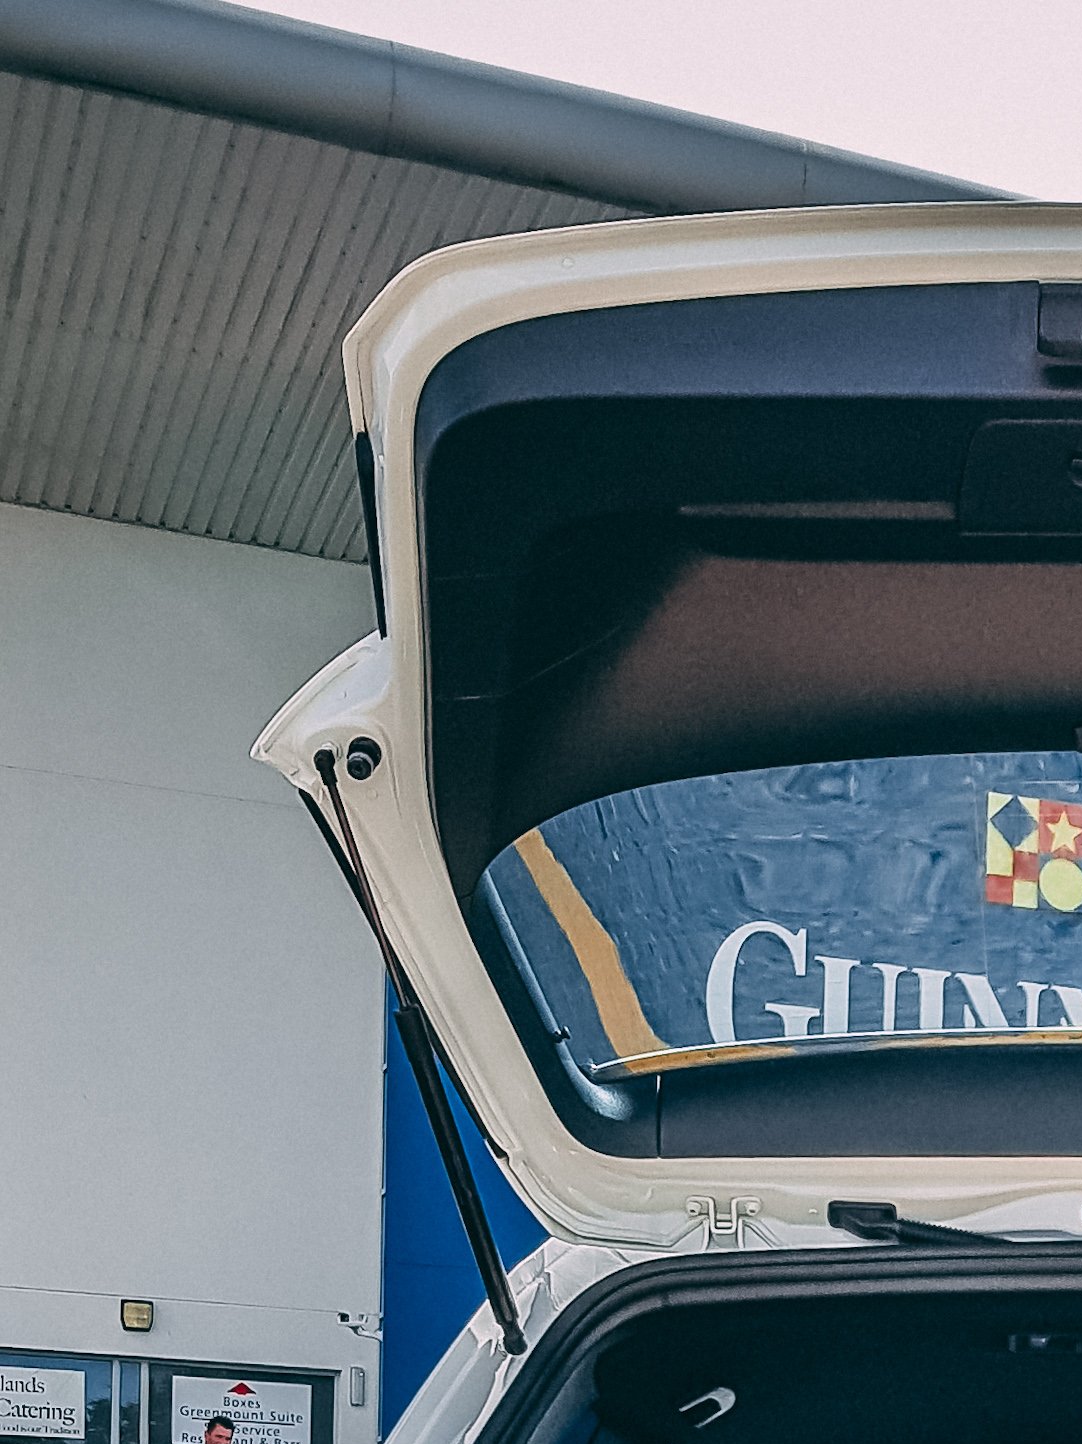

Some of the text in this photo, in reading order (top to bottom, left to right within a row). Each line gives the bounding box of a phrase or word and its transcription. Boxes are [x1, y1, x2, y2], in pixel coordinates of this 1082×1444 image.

[223, 1397, 260, 1408] Boxes
[180, 1406, 303, 1424] Greenmount Suite
[234, 1424, 280, 1437] Service
